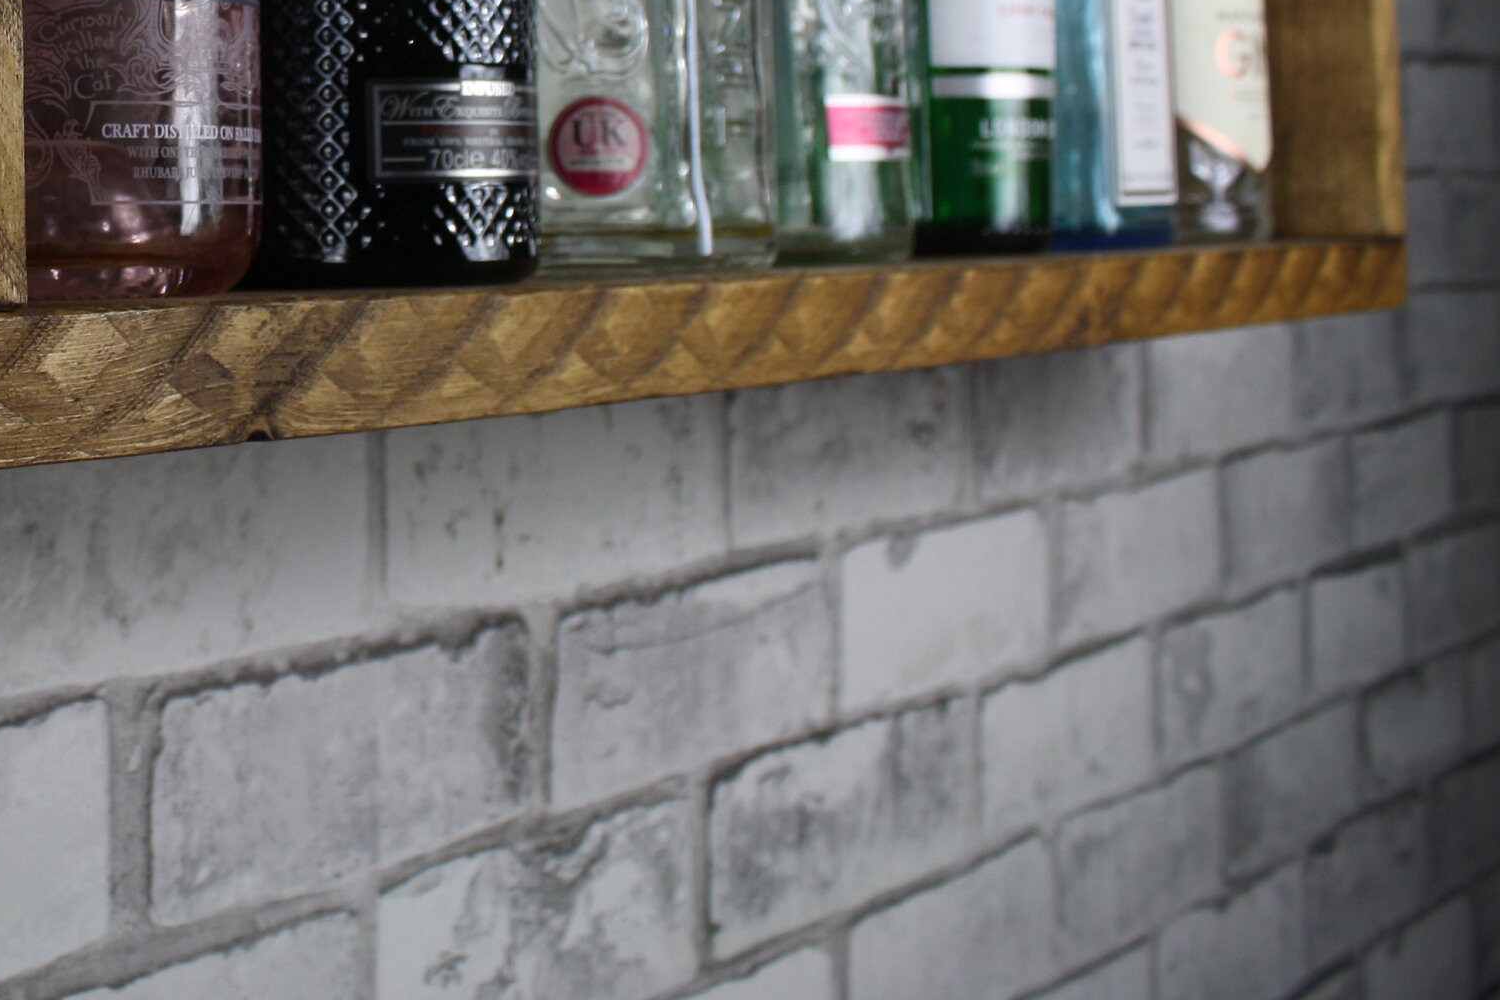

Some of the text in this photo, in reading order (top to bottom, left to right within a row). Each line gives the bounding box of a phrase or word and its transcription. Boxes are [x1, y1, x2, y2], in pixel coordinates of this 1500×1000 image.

[39, 3, 133, 42] Curiosity
[75, 53, 107, 70] the
[74, 72, 115, 99] Cat
[102, 123, 150, 138] CRAFT
[573, 119, 626, 148] UK
